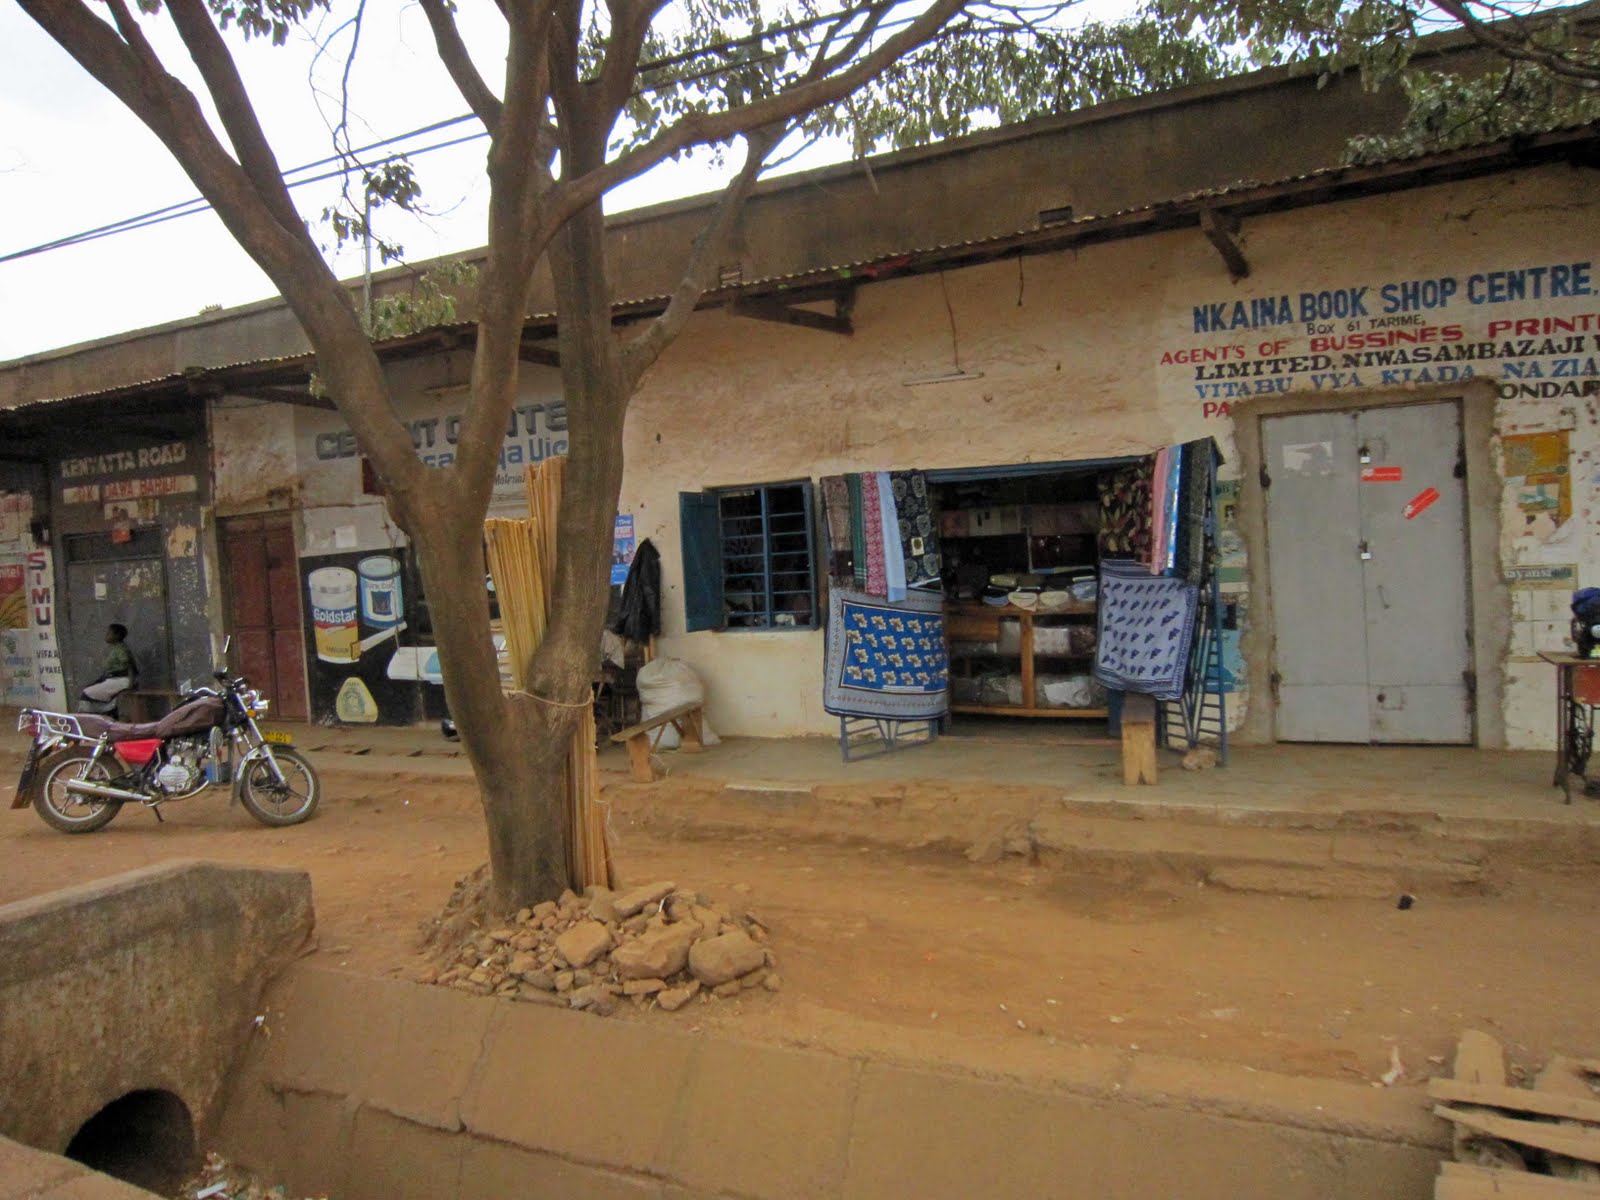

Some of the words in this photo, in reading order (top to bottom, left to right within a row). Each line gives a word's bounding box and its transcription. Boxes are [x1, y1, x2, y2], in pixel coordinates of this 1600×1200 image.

[1193, 295, 1294, 334] NKAINA
[1299, 286, 1369, 322] BOOK
[1381, 277, 1457, 313] SHOP
[1160, 345, 1246, 365] AGENT'S
[1258, 338, 1295, 356] OF
[1310, 324, 1464, 352] BUSSINES
[1488, 314, 1600, 339] PRINT
[1347, 321, 1360, 332] 61
[1195, 376, 1293, 399] VITABU
[1310, 372, 1364, 390] VYA
[1381, 365, 1475, 385] KIADA
[1502, 361, 1544, 379] NA
[1551, 357, 1600, 377] ZIA
[1203, 401, 1231, 419] PA
[1499, 380, 1600, 400] ONDAR
[138, 442, 187, 467] ROAD
[313, 608, 357, 624] Goldstar
